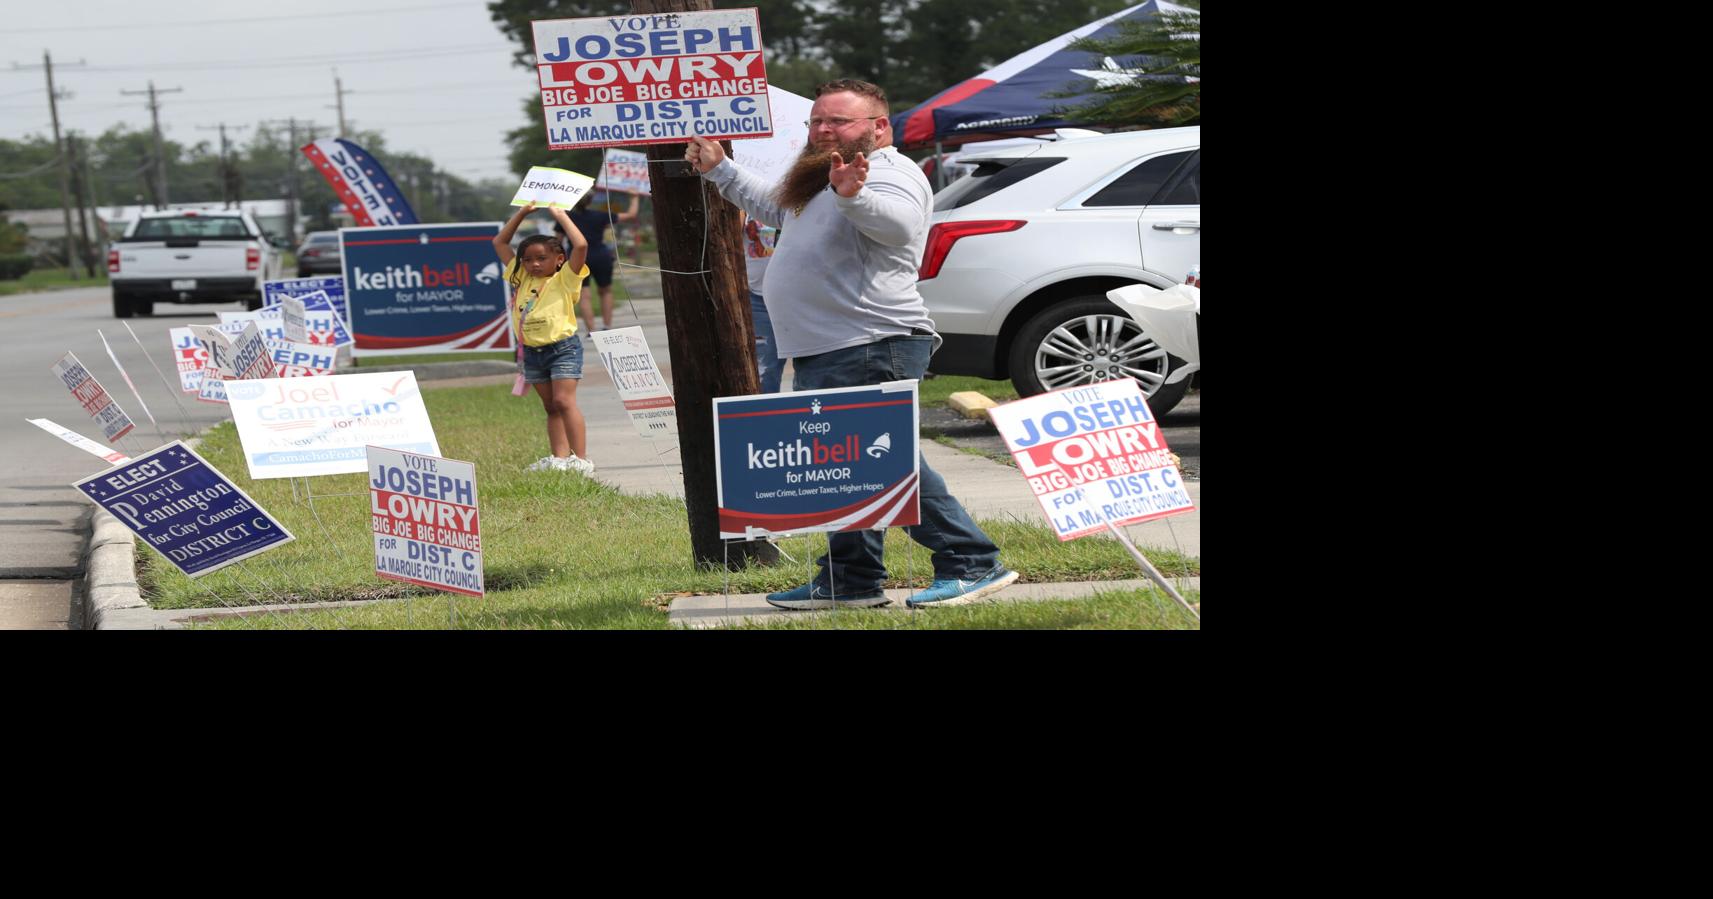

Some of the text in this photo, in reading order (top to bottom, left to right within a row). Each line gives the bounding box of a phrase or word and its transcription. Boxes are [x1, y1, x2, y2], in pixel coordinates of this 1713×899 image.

[608, 14, 682, 33] VOTE
[543, 26, 754, 62] JOSEPH
[538, 53, 761, 88] LOWRY
[541, 78, 768, 106] BIG JOE BIG CHANGE
[556, 97, 756, 122] FOR DIST. C
[550, 127, 571, 143] LA
[576, 123, 646, 142] MARQUE
[650, 120, 689, 138] CITY
[694, 116, 769, 135] COUNCIL
[331, 150, 380, 210] VOTE
[522, 180, 583, 195] LEMONADE
[395, 290, 464, 303] for MAYOR
[233, 333, 265, 377] JOSEPH
[273, 349, 331, 369] EPH
[200, 390, 212, 398] LA
[274, 381, 340, 405] Joel
[1061, 386, 1104, 405] VOTE
[257, 399, 401, 421] Camacho
[1014, 396, 1149, 447] JOSEPH
[799, 420, 831, 435] Keep
[402, 454, 438, 473] VOTE
[1014, 423, 1161, 477] LOWRY
[106, 458, 168, 491] ELECT
[372, 465, 473, 506] JOSEPH
[786, 467, 851, 484] for MAYOR
[1028, 448, 1174, 495] BIG JOE BIG CHANGE
[1106, 473, 1158, 499] DIST.
[1161, 469, 1177, 488] C
[132, 479, 184, 506] David
[755, 482, 884, 499] Lower Crime, Lower Taxes, Higher Hopes
[110, 482, 233, 531] Pennington
[148, 498, 253, 546] for City Council
[371, 490, 476, 532] LOWRY
[1053, 514, 1078, 533] LA
[1131, 494, 1152, 513] CITY
[1152, 489, 1190, 510] COUNCIL
[168, 523, 252, 562] DISTRICT
[252, 517, 271, 531] C
[373, 516, 480, 550] BIG JOE BIG CHANGE
[379, 539, 475, 571] FOR DIST. C
[376, 555, 387, 570] LA
[389, 558, 422, 578] MARQUE
[424, 563, 442, 581] CITY
[445, 569, 481, 591] COUNCIL
